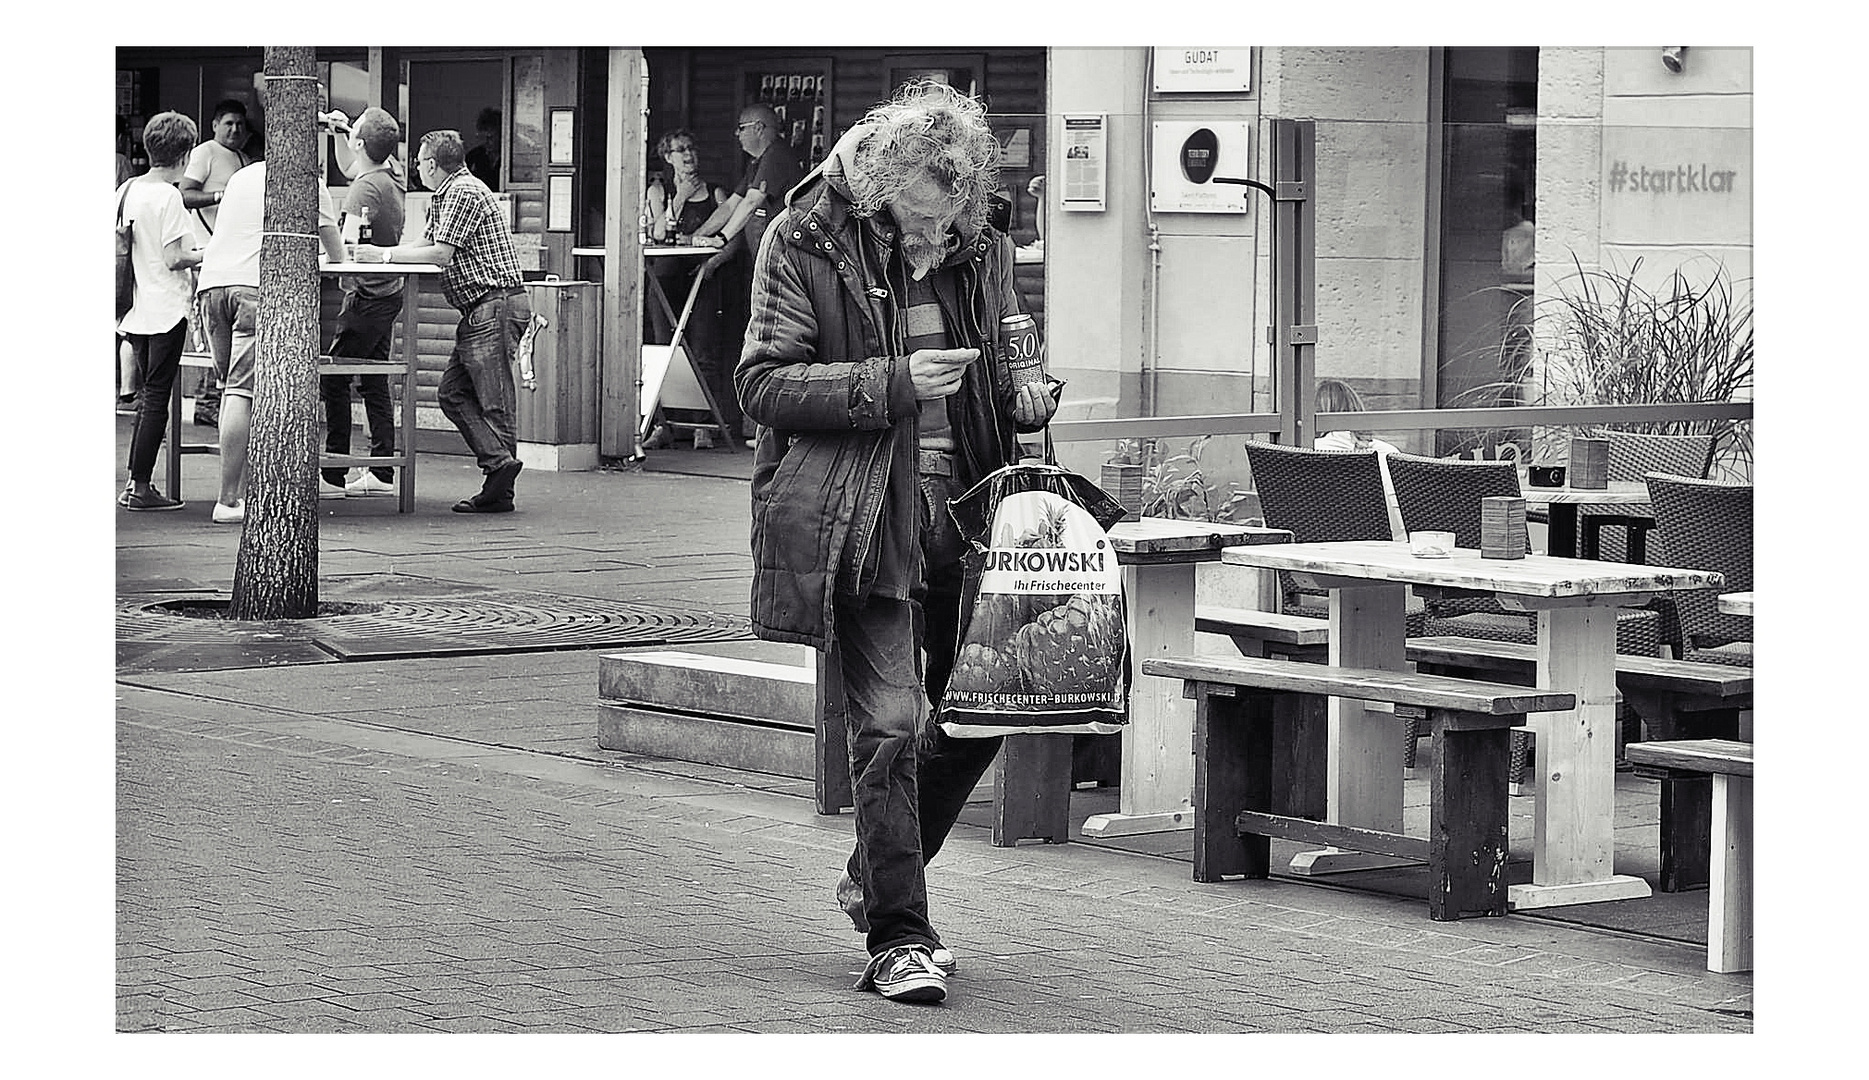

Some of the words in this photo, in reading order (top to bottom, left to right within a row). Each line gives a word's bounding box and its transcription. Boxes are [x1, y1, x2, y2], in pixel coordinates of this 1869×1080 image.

[1185, 50, 1219, 64] GUDAT
[1608, 161, 1736, 193] #startklar
[1008, 333, 1036, 360] 5,0
[1030, 579, 1106, 592] Frischecenter
[945, 690, 1121, 704] WWW.FRISCHECENTER-BURKOWSKI.D
